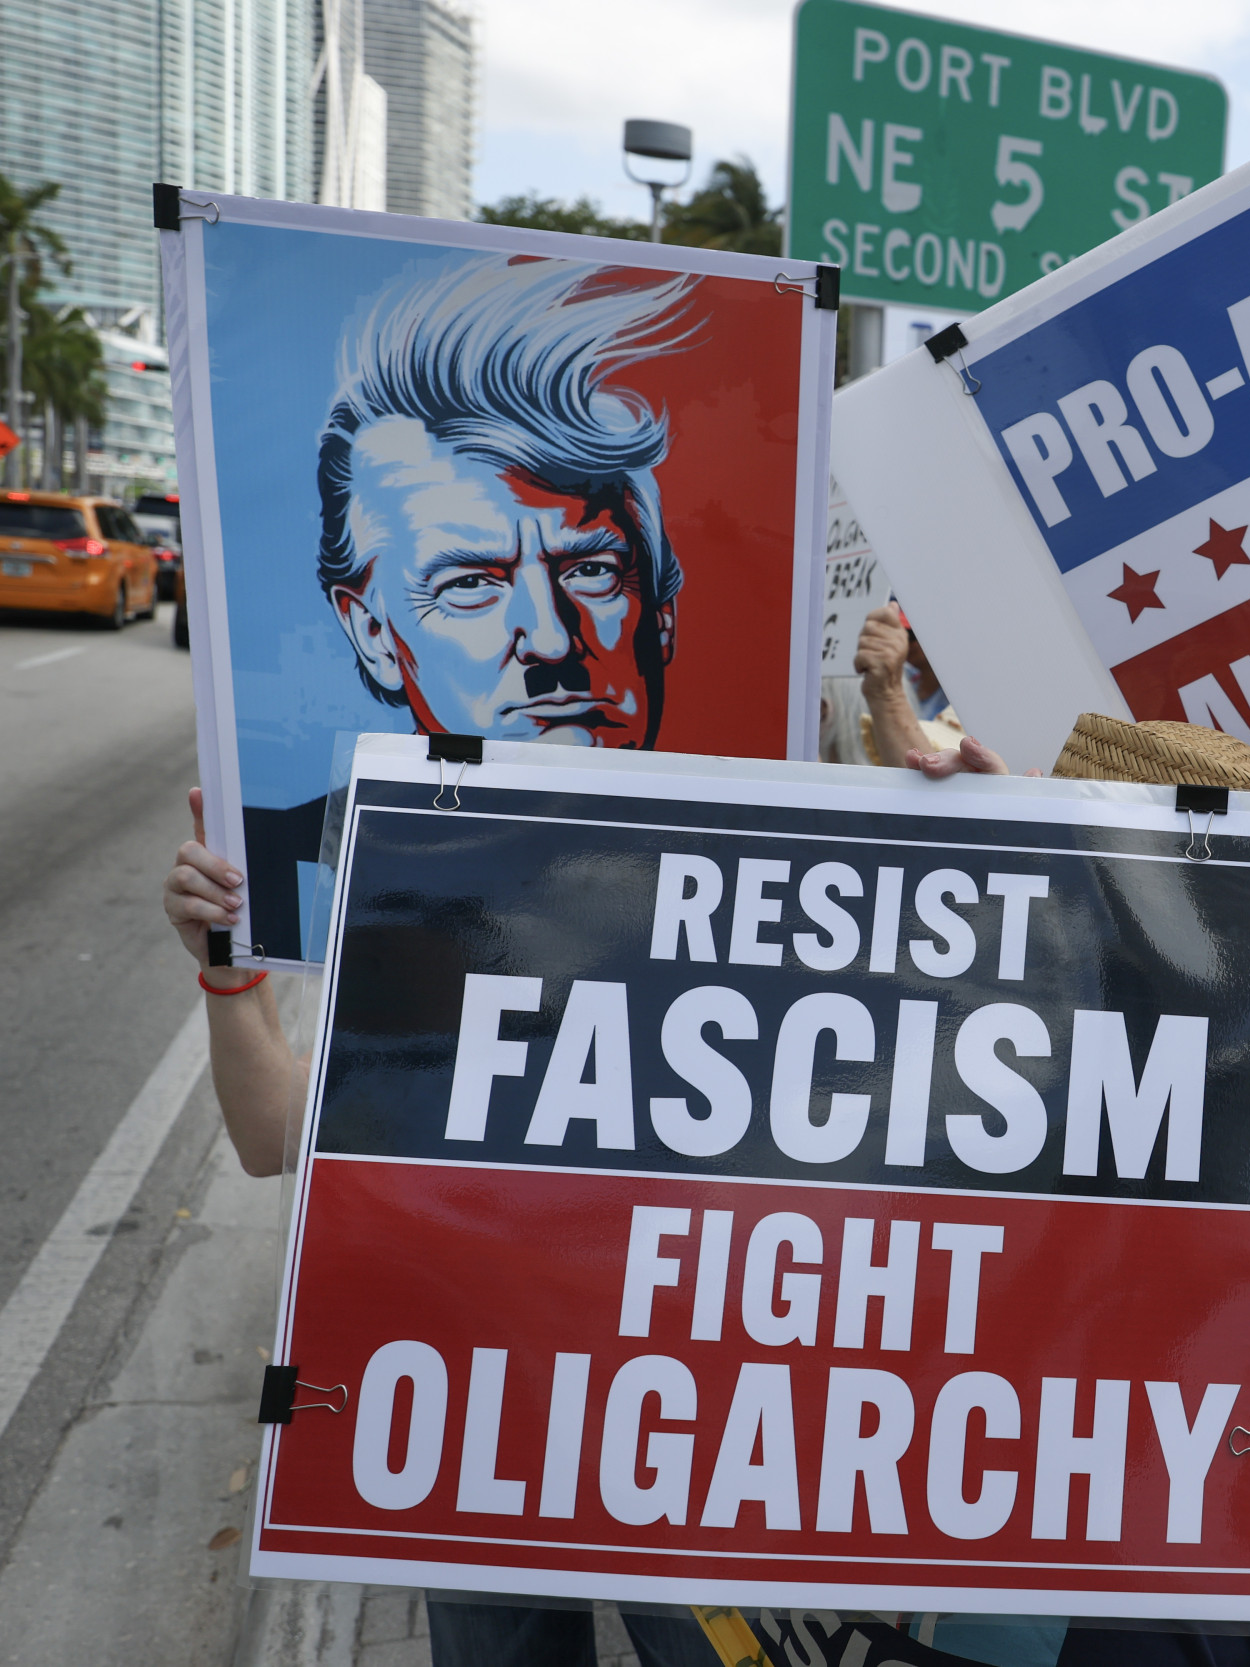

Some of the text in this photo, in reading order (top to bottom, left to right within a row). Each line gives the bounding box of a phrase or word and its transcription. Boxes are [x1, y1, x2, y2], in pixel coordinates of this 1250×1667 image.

[853, 27, 1179, 142] PORT BLVD
[826, 112, 924, 214] NE
[990, 134, 1044, 234] 5
[820, 218, 1007, 298] SECOND
[649, 852, 1050, 981] RESIST
[444, 972, 1210, 1183] FASCISM
[618, 1205, 1005, 1355] FIGHT
[351, 1339, 1243, 1545] OLIGARCHY
